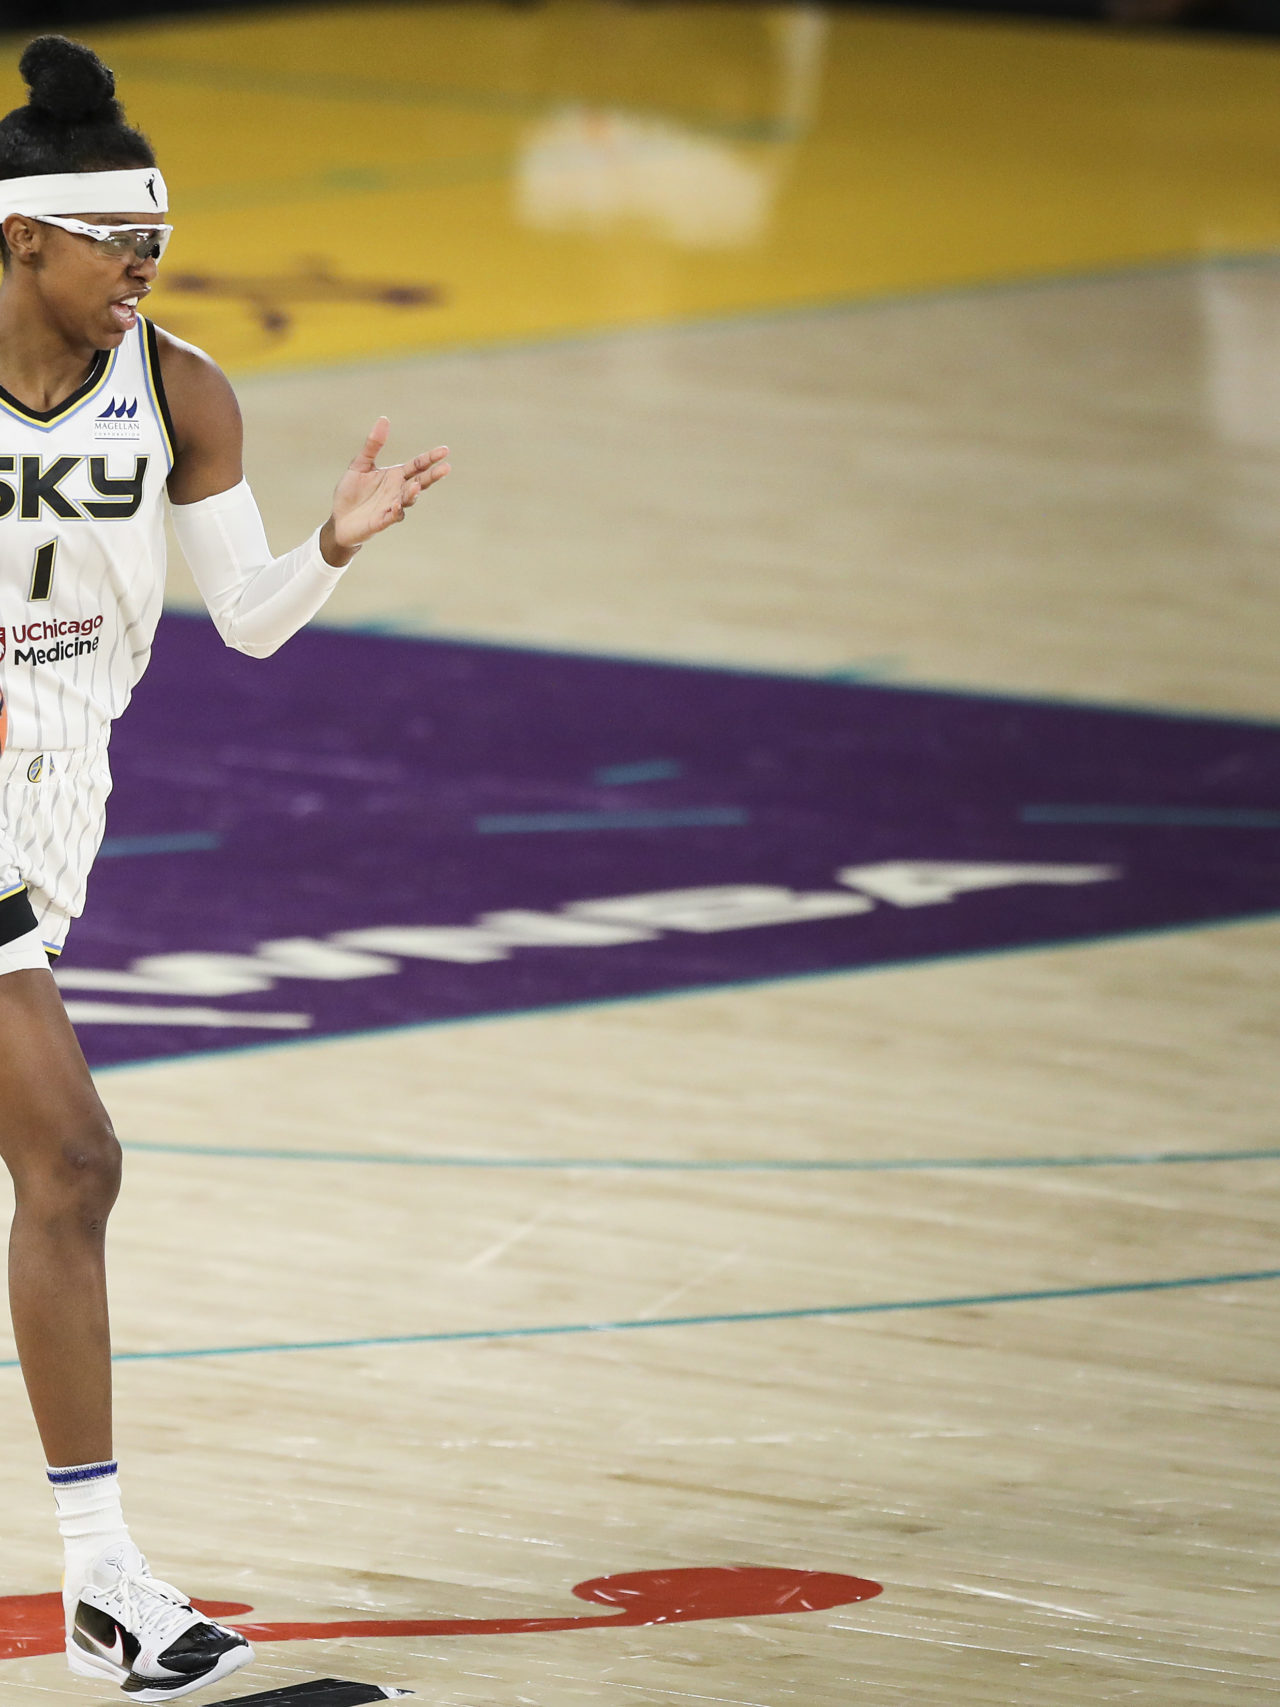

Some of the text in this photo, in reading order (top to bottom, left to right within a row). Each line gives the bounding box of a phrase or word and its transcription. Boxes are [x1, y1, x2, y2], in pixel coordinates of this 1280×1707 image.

[28, 537, 58, 601] 1
[12, 615, 103, 643] UChicago
[14, 636, 99, 666] Medicine
